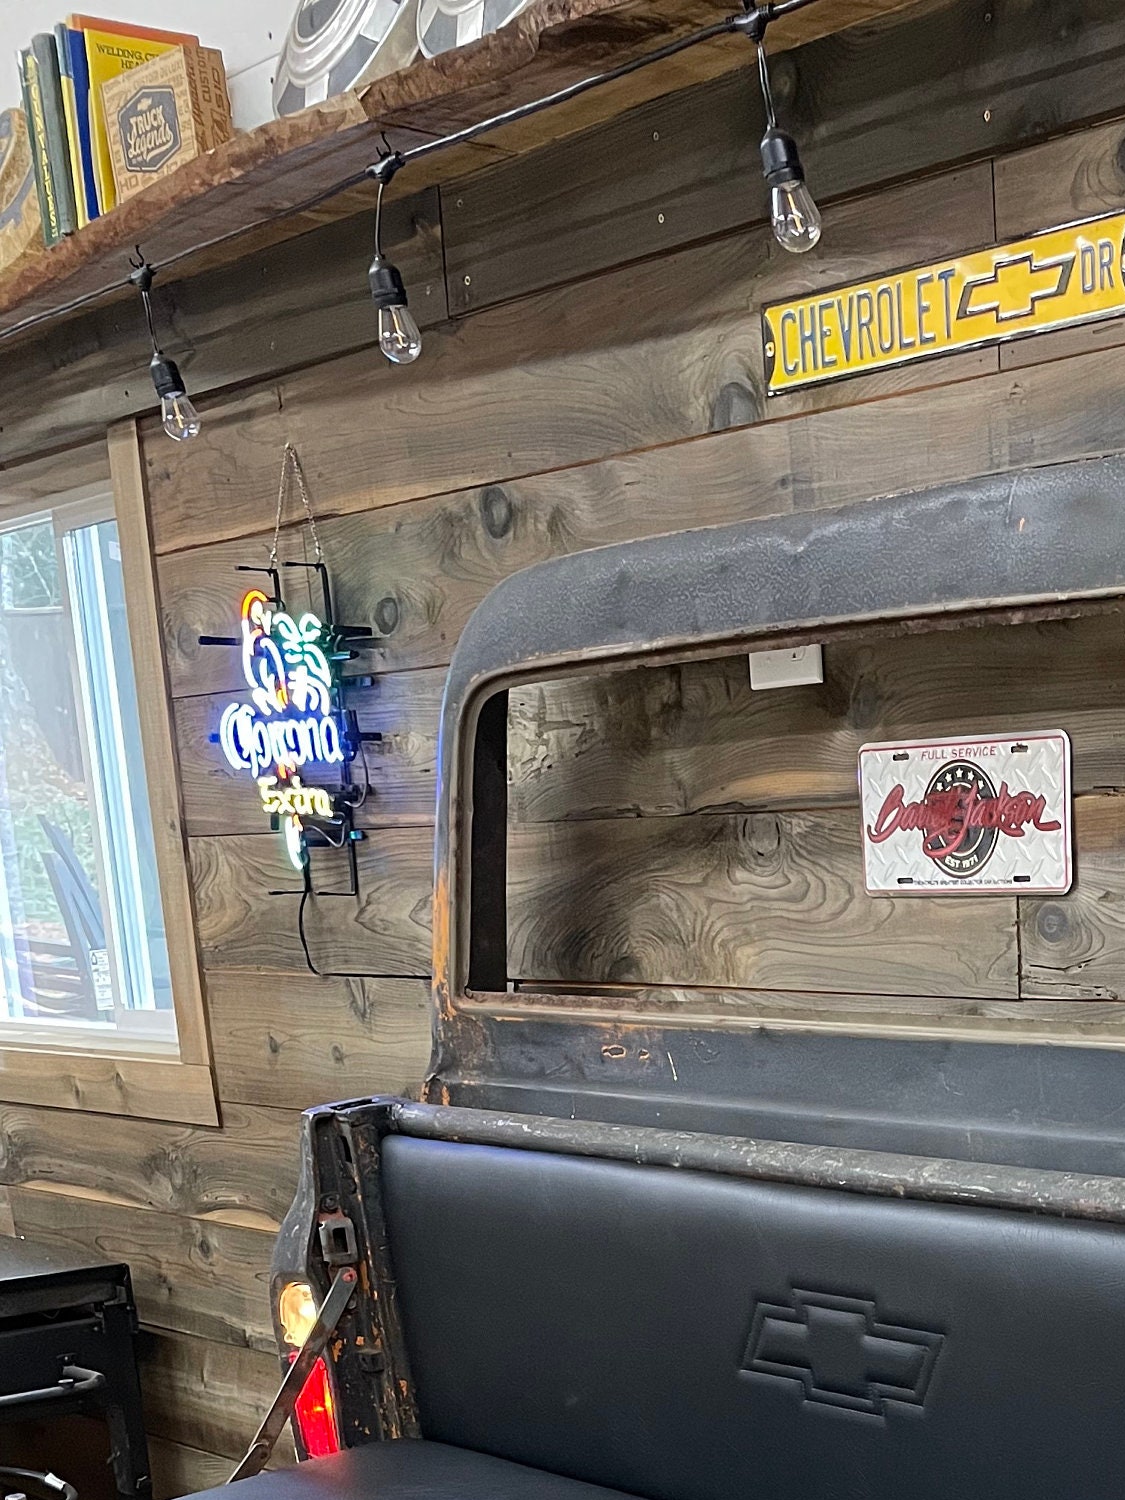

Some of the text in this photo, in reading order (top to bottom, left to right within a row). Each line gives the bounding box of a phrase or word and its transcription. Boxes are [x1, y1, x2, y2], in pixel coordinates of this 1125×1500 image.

[129, 105, 165, 134] TRUCK
[127, 123, 174, 161] Legends
[780, 240, 1115, 377] CHEVROLET DR
[219, 702, 344, 779] Corona
[921, 746, 997, 761] FULL SERVICE
[257, 775, 333, 817] Extra
[945, 855, 960, 868] EST
